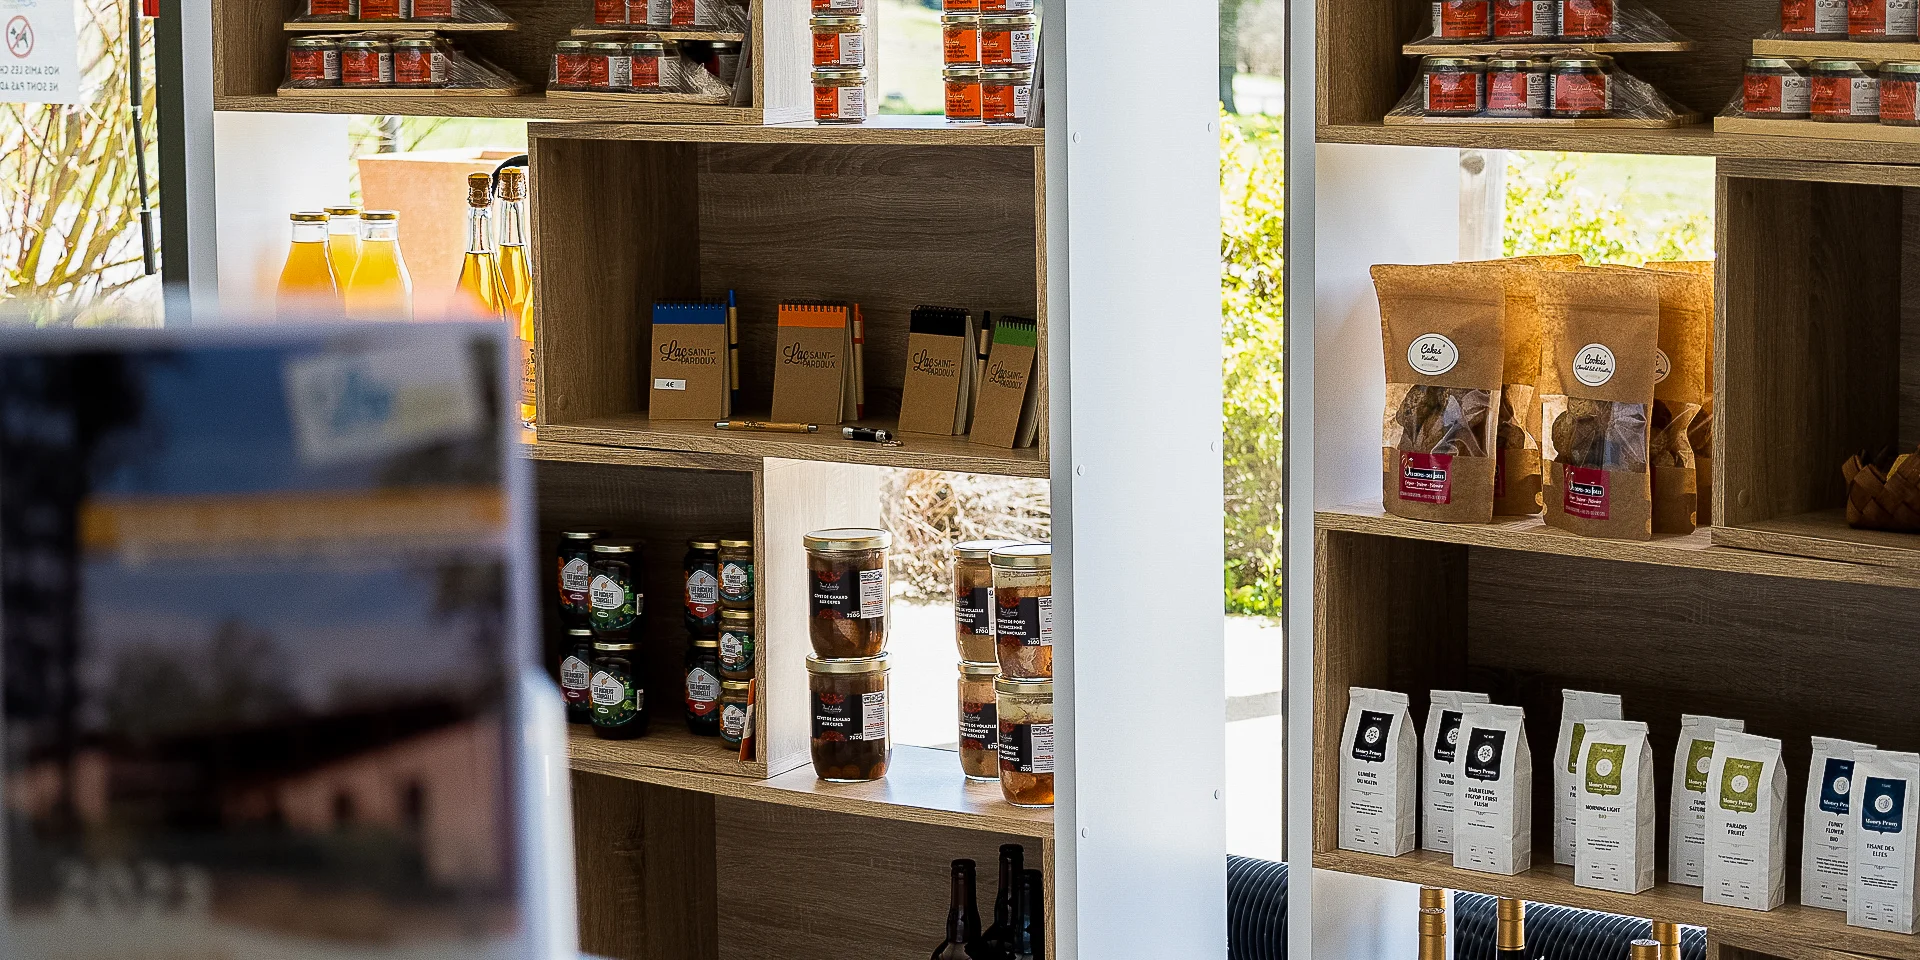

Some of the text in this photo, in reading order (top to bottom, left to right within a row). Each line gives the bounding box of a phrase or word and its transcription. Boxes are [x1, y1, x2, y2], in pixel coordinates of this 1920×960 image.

[659, 339, 687, 362] Lac
[782, 341, 809, 365] Lac
[912, 348, 934, 372] Lac
[989, 360, 1008, 383] Lac
[1585, 804, 1606, 812] MORNING
